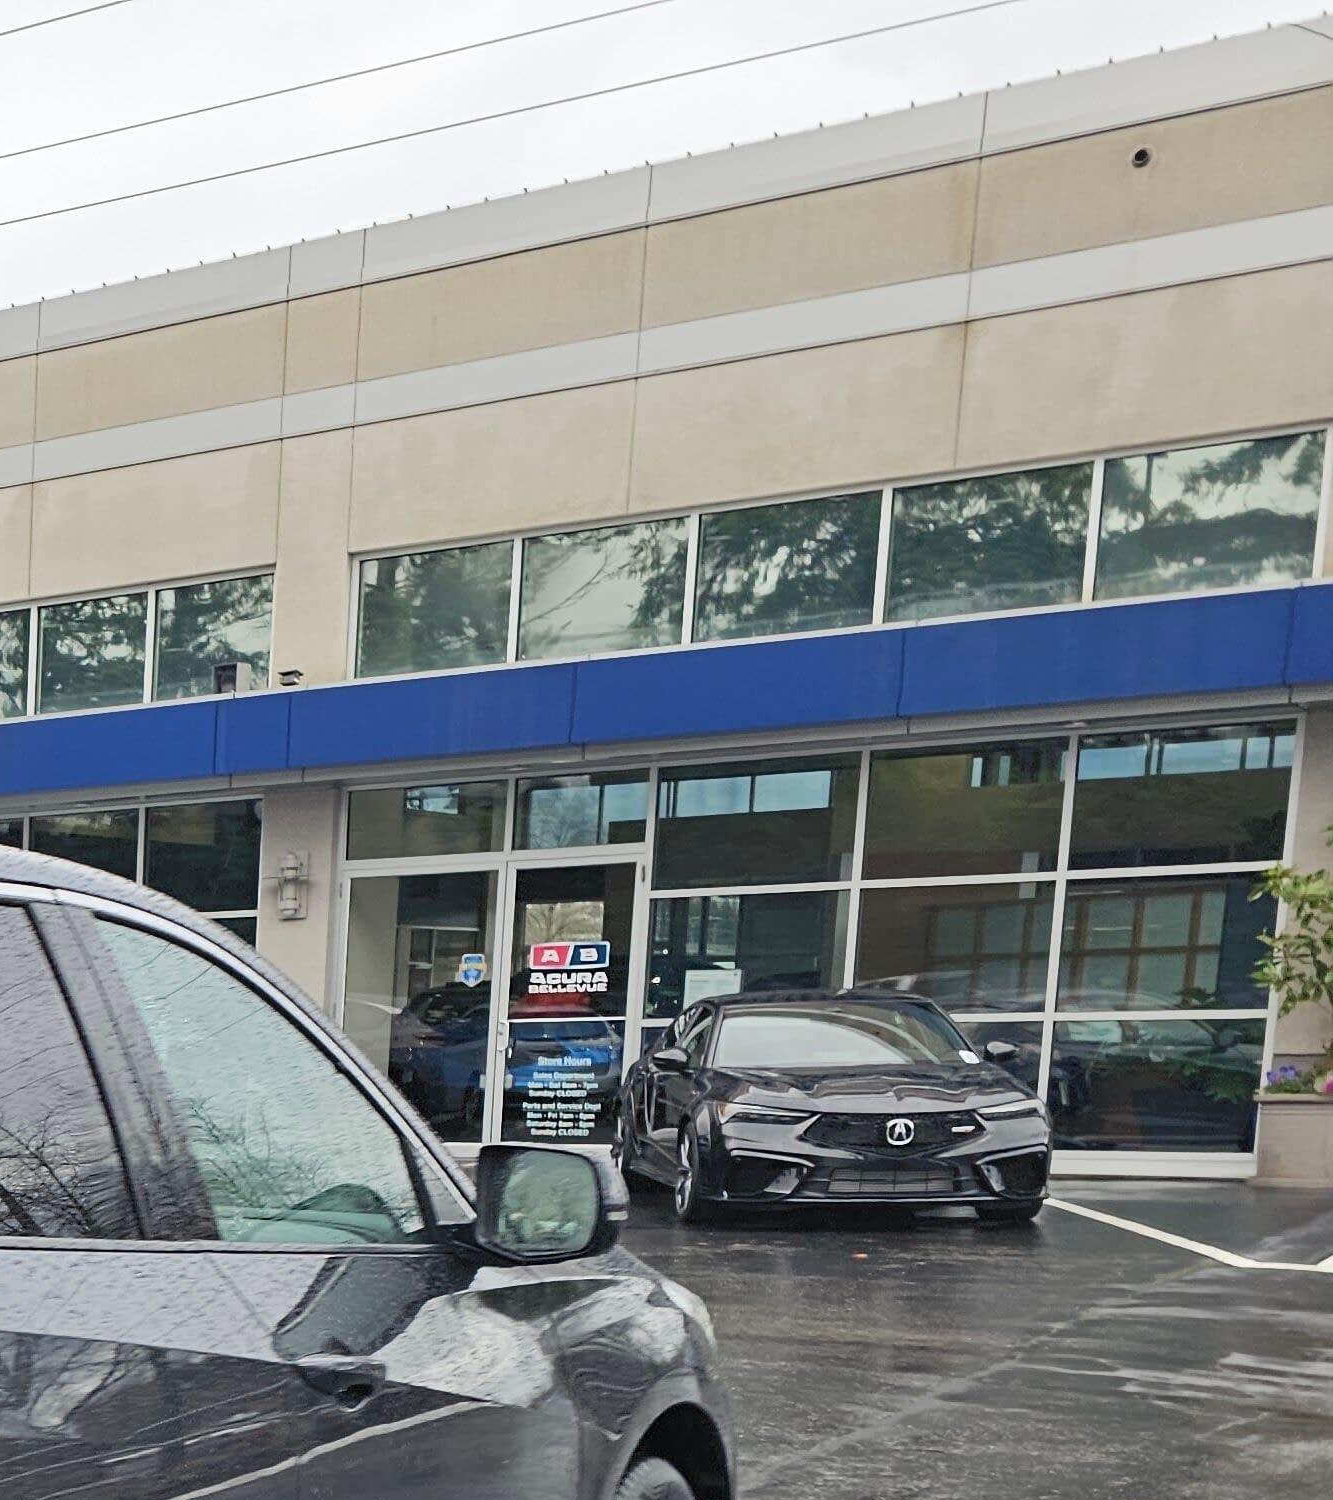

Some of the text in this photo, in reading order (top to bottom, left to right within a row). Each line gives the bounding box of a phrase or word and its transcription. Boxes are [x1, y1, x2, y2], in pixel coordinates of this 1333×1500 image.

[541, 948, 598, 963] A B
[529, 971, 608, 984] ACURA
[528, 983, 608, 994] BELLEVUE
[538, 1056, 592, 1067] Store Hours
[528, 1090, 587, 1099] Sunday CLOSED
[522, 1102, 541, 1110] Parts
[541, 1102, 556, 1110] and
[556, 1102, 583, 1110] Service
[526, 1120, 557, 1129] Saturday
[530, 1128, 590, 1137] Sunday CLOSED
